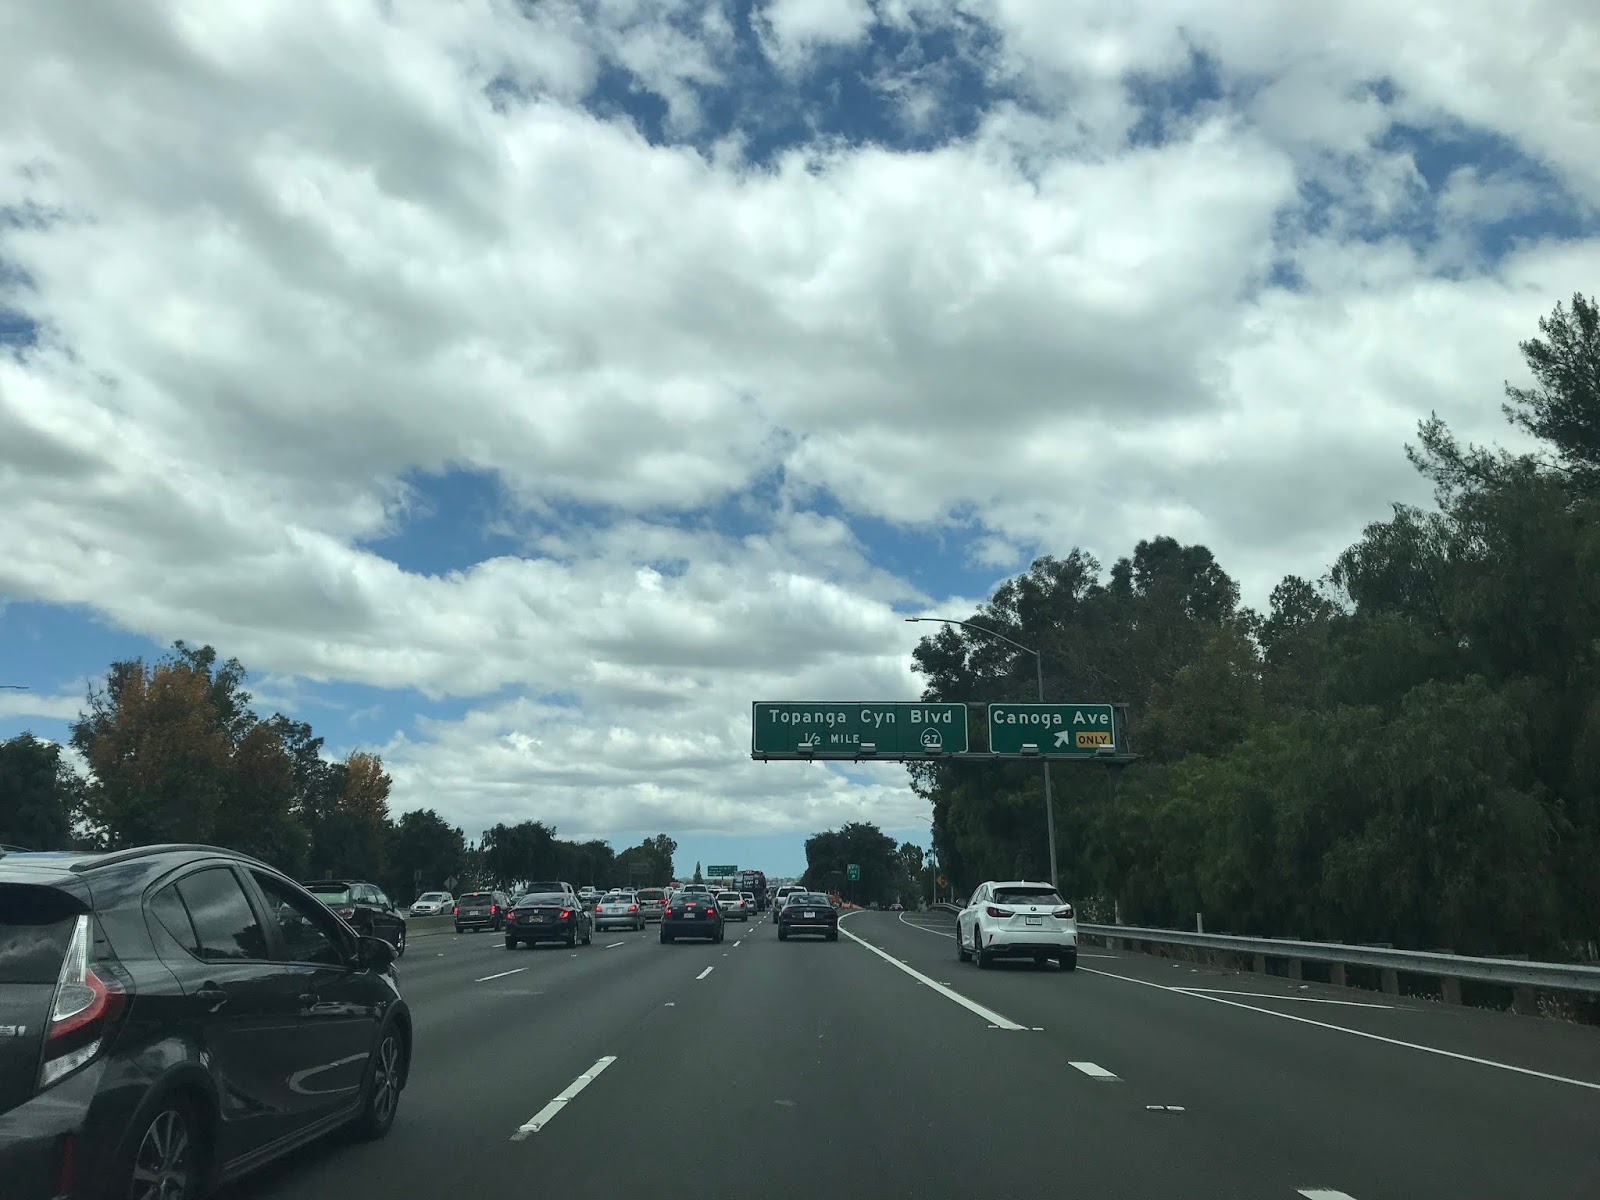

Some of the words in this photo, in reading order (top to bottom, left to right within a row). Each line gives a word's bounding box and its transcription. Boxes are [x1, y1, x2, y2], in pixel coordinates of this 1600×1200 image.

[769, 709, 846, 728] Topanga
[860, 709, 896, 728] Cyn
[910, 709, 952, 723] Blvd
[993, 710, 1062, 729] Canoga
[1073, 710, 1109, 724] Ave
[831, 734, 860, 744] MILE
[923, 734, 939, 744] 27
[1078, 735, 1108, 745] ONLY
